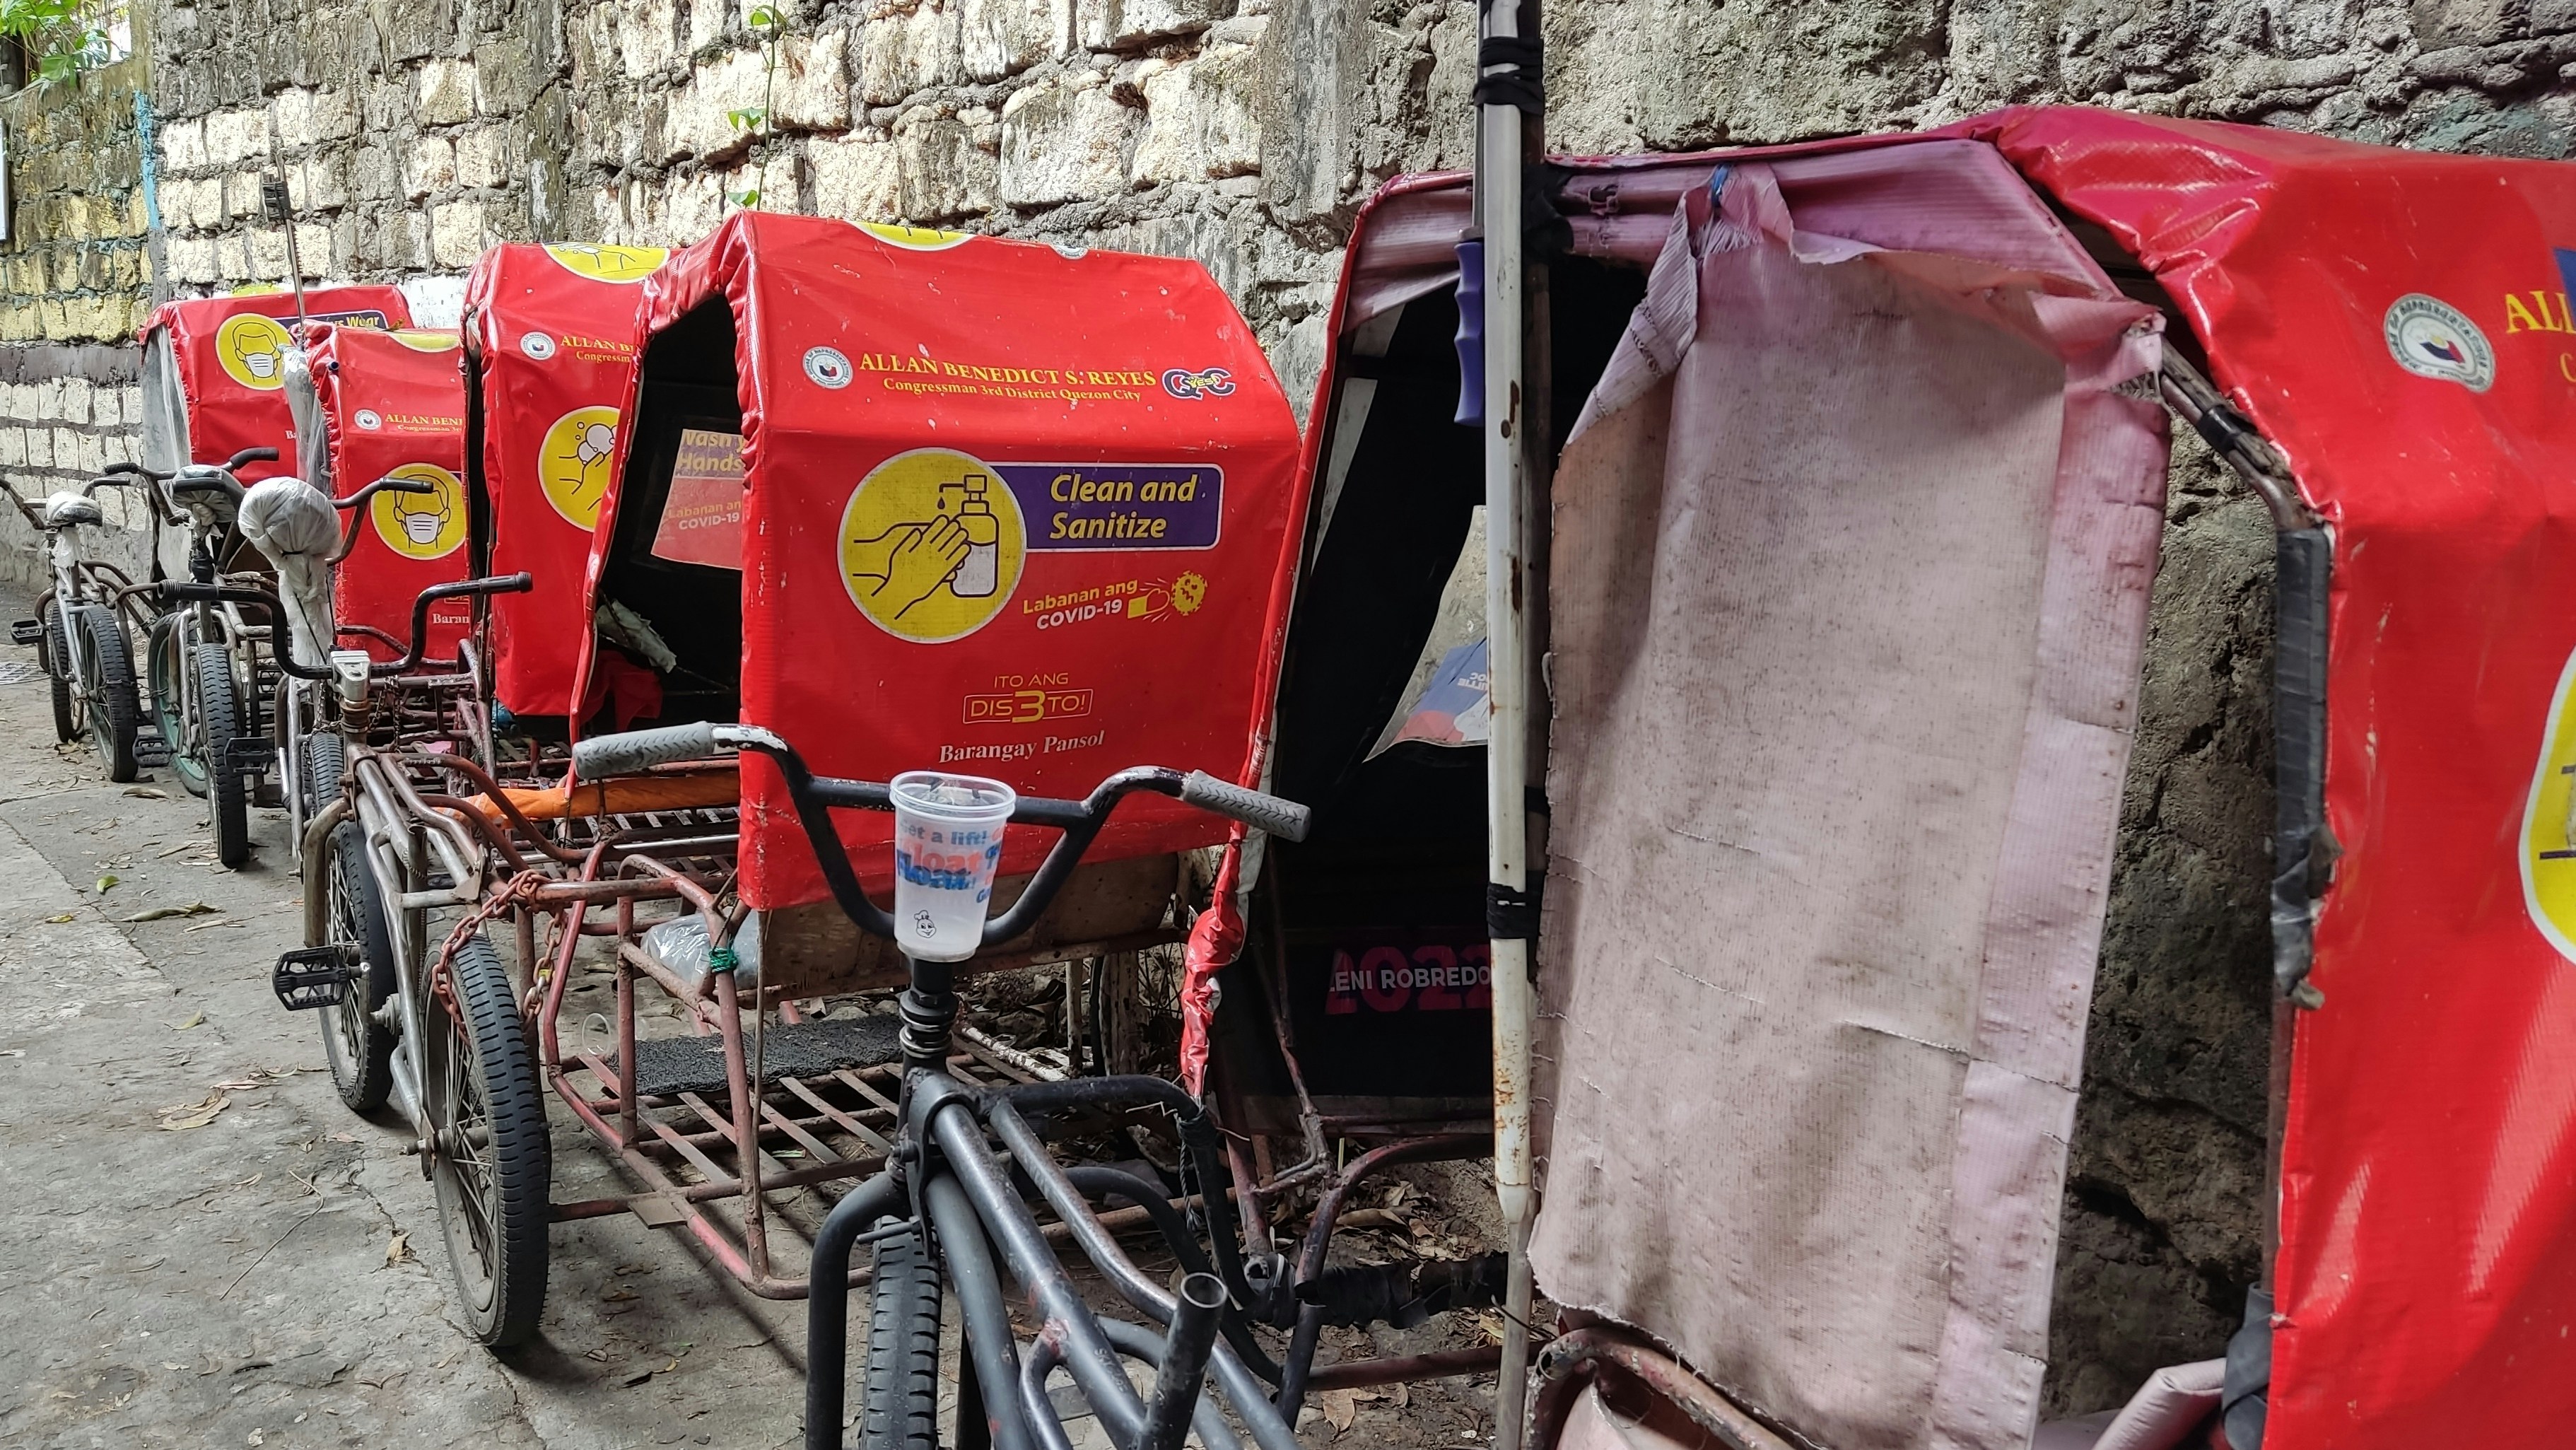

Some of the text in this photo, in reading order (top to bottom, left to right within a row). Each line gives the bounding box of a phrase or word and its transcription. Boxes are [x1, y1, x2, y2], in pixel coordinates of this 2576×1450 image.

[561, 336, 615, 350] ALLAN
[860, 353, 939, 375] ALLAN
[942, 361, 1059, 384] BENEDICT
[1087, 370, 1157, 386] REYES
[884, 378, 1140, 402] Congressman 3rd District Quezon City
[385, 414, 429, 424] ALLAN
[677, 452, 744, 472] Hands
[1050, 474, 1198, 502] Clean and
[668, 503, 723, 519] Labanan
[679, 512, 740, 530] COVID-19
[1050, 511, 1166, 539] Sanitize
[1023, 580, 1138, 614] Labanan ang
[1036, 599, 1123, 630] COVID-19
[994, 672, 1069, 689] ITO ANG
[939, 730, 1105, 764] Barangay Pansol
[932, 831, 943, 843] a
[1330, 966, 1492, 992] ENI ROBREDO
